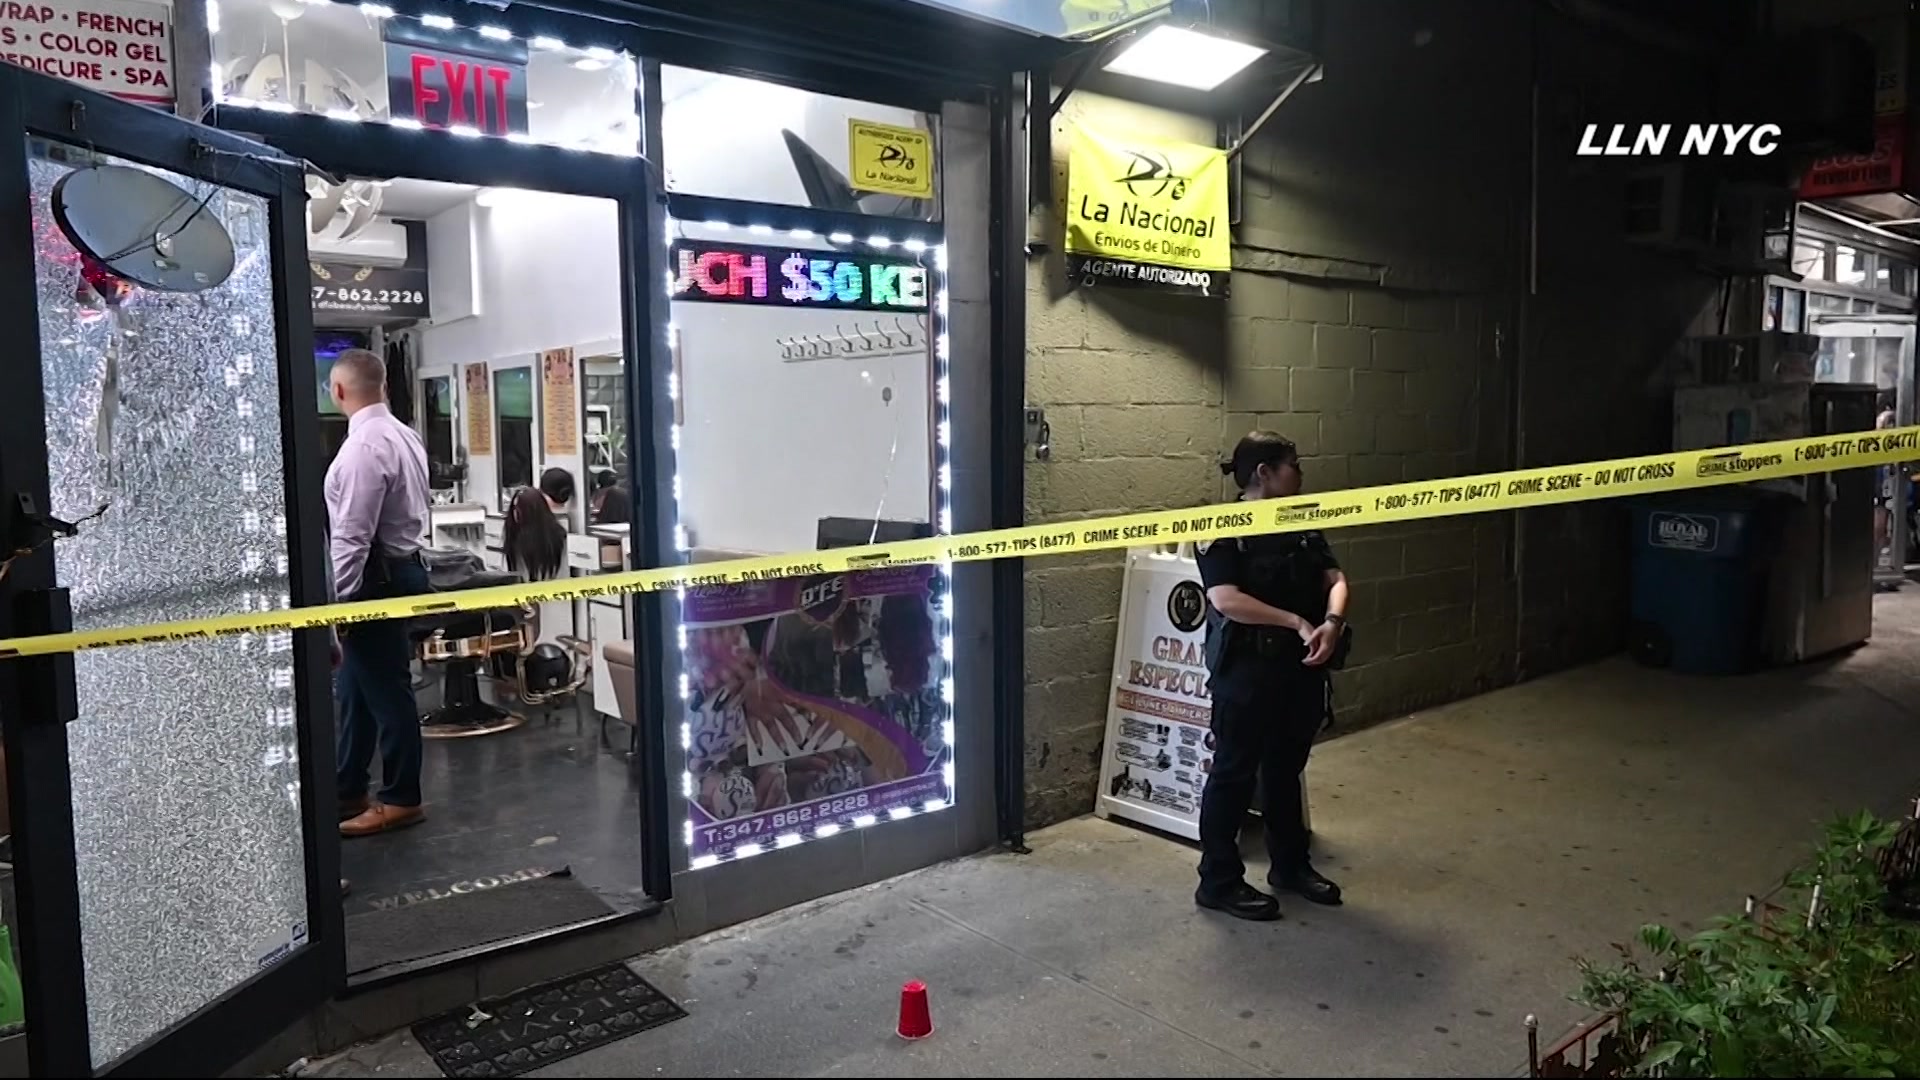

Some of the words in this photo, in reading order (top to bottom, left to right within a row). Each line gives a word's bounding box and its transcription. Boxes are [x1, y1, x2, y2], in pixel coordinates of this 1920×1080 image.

[77, 11, 164, 38] FRENCH
[40, 32, 117, 58] COLOR
[126, 43, 167, 62] GEL
[125, 67, 168, 88] SPA
[410, 52, 511, 137] EXIT
[1081, 194, 1109, 223] La
[1120, 201, 1215, 238] Nacional
[1143, 238, 1158, 253] de
[1161, 240, 1201, 259] Dinero
[781, 252, 863, 303] $50
[1081, 260, 1137, 279] AGENTE
[1138, 266, 1211, 288] AUTORIZADO
[312, 286, 424, 305] 7-862.2228
[1728, 453, 1783, 471] stoppers
[1794, 440, 1880, 461] 1-800-577-TIPS
[1305, 503, 1362, 520] stoppers
[1375, 486, 1463, 512] 1-800-577-TIPS
[1465, 481, 1501, 501] (8477)
[1508, 476, 1544, 496] CRIME
[1546, 473, 1583, 492] SCENE
[1594, 470, 1610, 486] DO
[1612, 467, 1635, 484] NOT
[1638, 461, 1674, 480] CROSS
[948, 536, 1037, 560] 1-800-577-TIPS
[1039, 531, 1076, 551] (8477)
[1083, 527, 1119, 545] CRIME
[1122, 523, 1159, 541] SCENE
[1172, 519, 1188, 535] DO
[1190, 516, 1212, 532] NOT
[1215, 512, 1254, 529] CROSS
[368, 867, 552, 910] WELCOME
